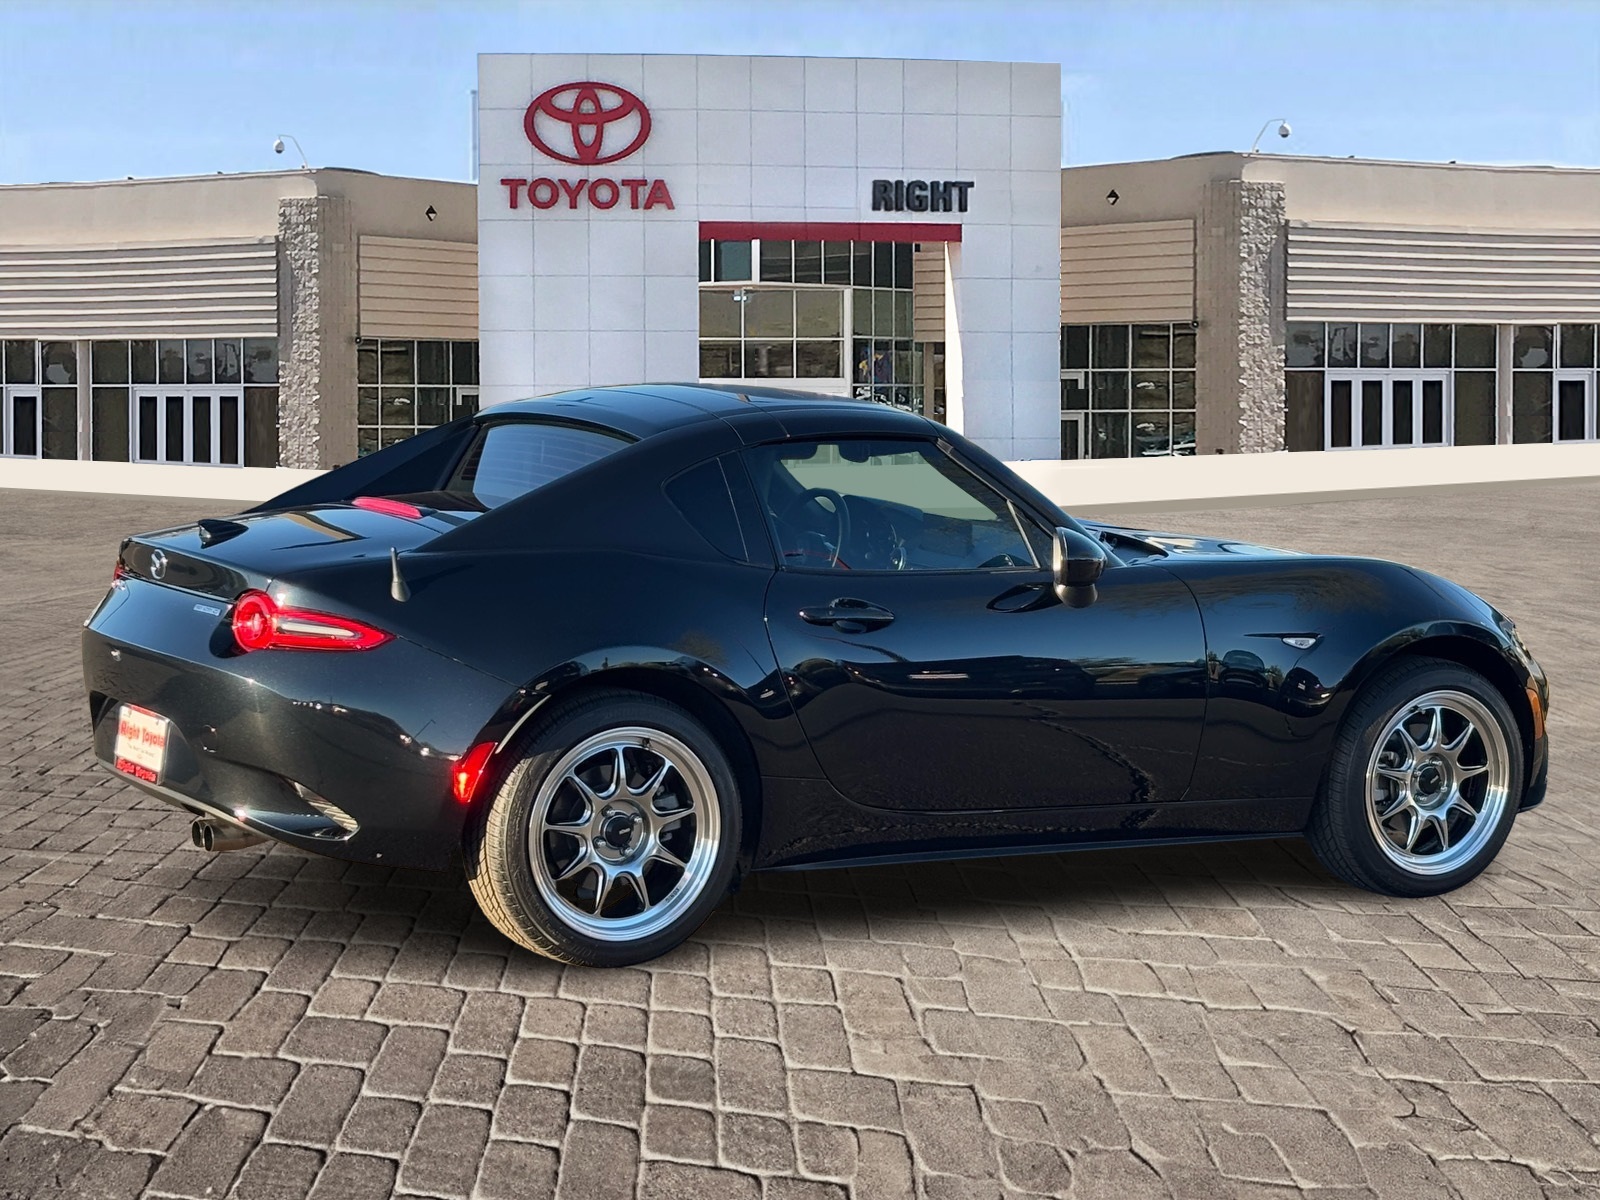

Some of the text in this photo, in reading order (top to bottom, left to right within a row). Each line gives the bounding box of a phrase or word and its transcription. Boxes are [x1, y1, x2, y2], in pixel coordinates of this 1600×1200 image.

[501, 178, 675, 211] TOYOTA
[872, 179, 975, 213] RIGHT
[120, 720, 166, 748] Right Toyota
